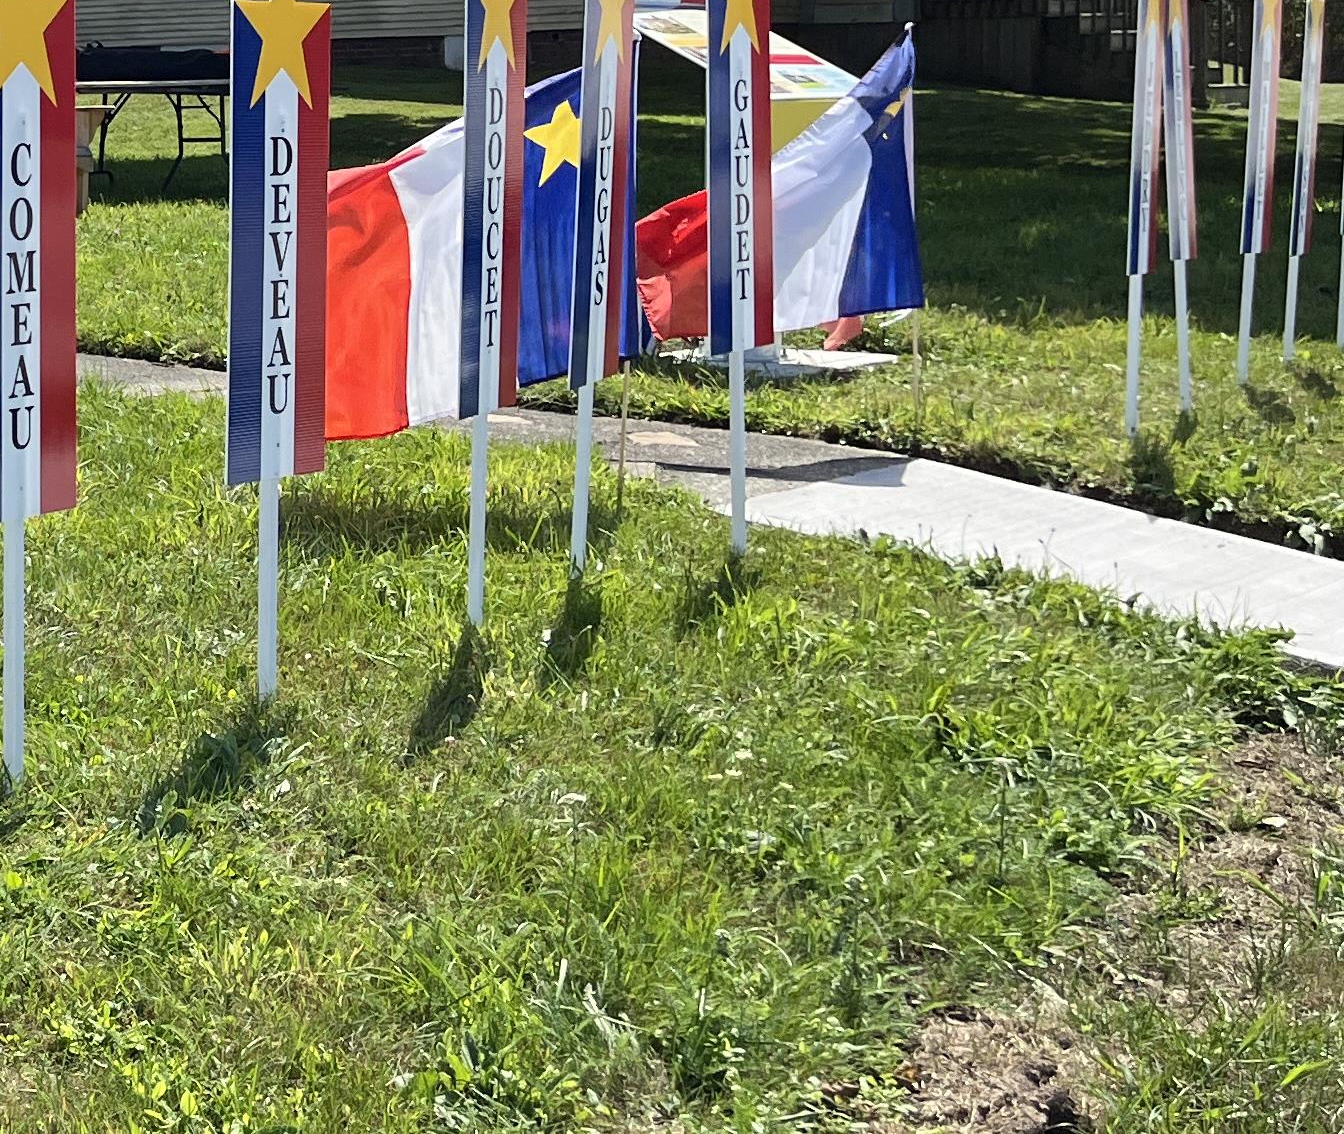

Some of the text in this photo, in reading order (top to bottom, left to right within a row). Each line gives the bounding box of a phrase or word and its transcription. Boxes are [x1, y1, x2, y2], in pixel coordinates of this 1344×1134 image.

[5, 141, 38, 451] COMEAU
[265, 135, 294, 416] DEVEAU
[484, 86, 505, 349] DOUCET
[593, 106, 614, 307] DUGAS
[732, 78, 754, 302] GAUDET
